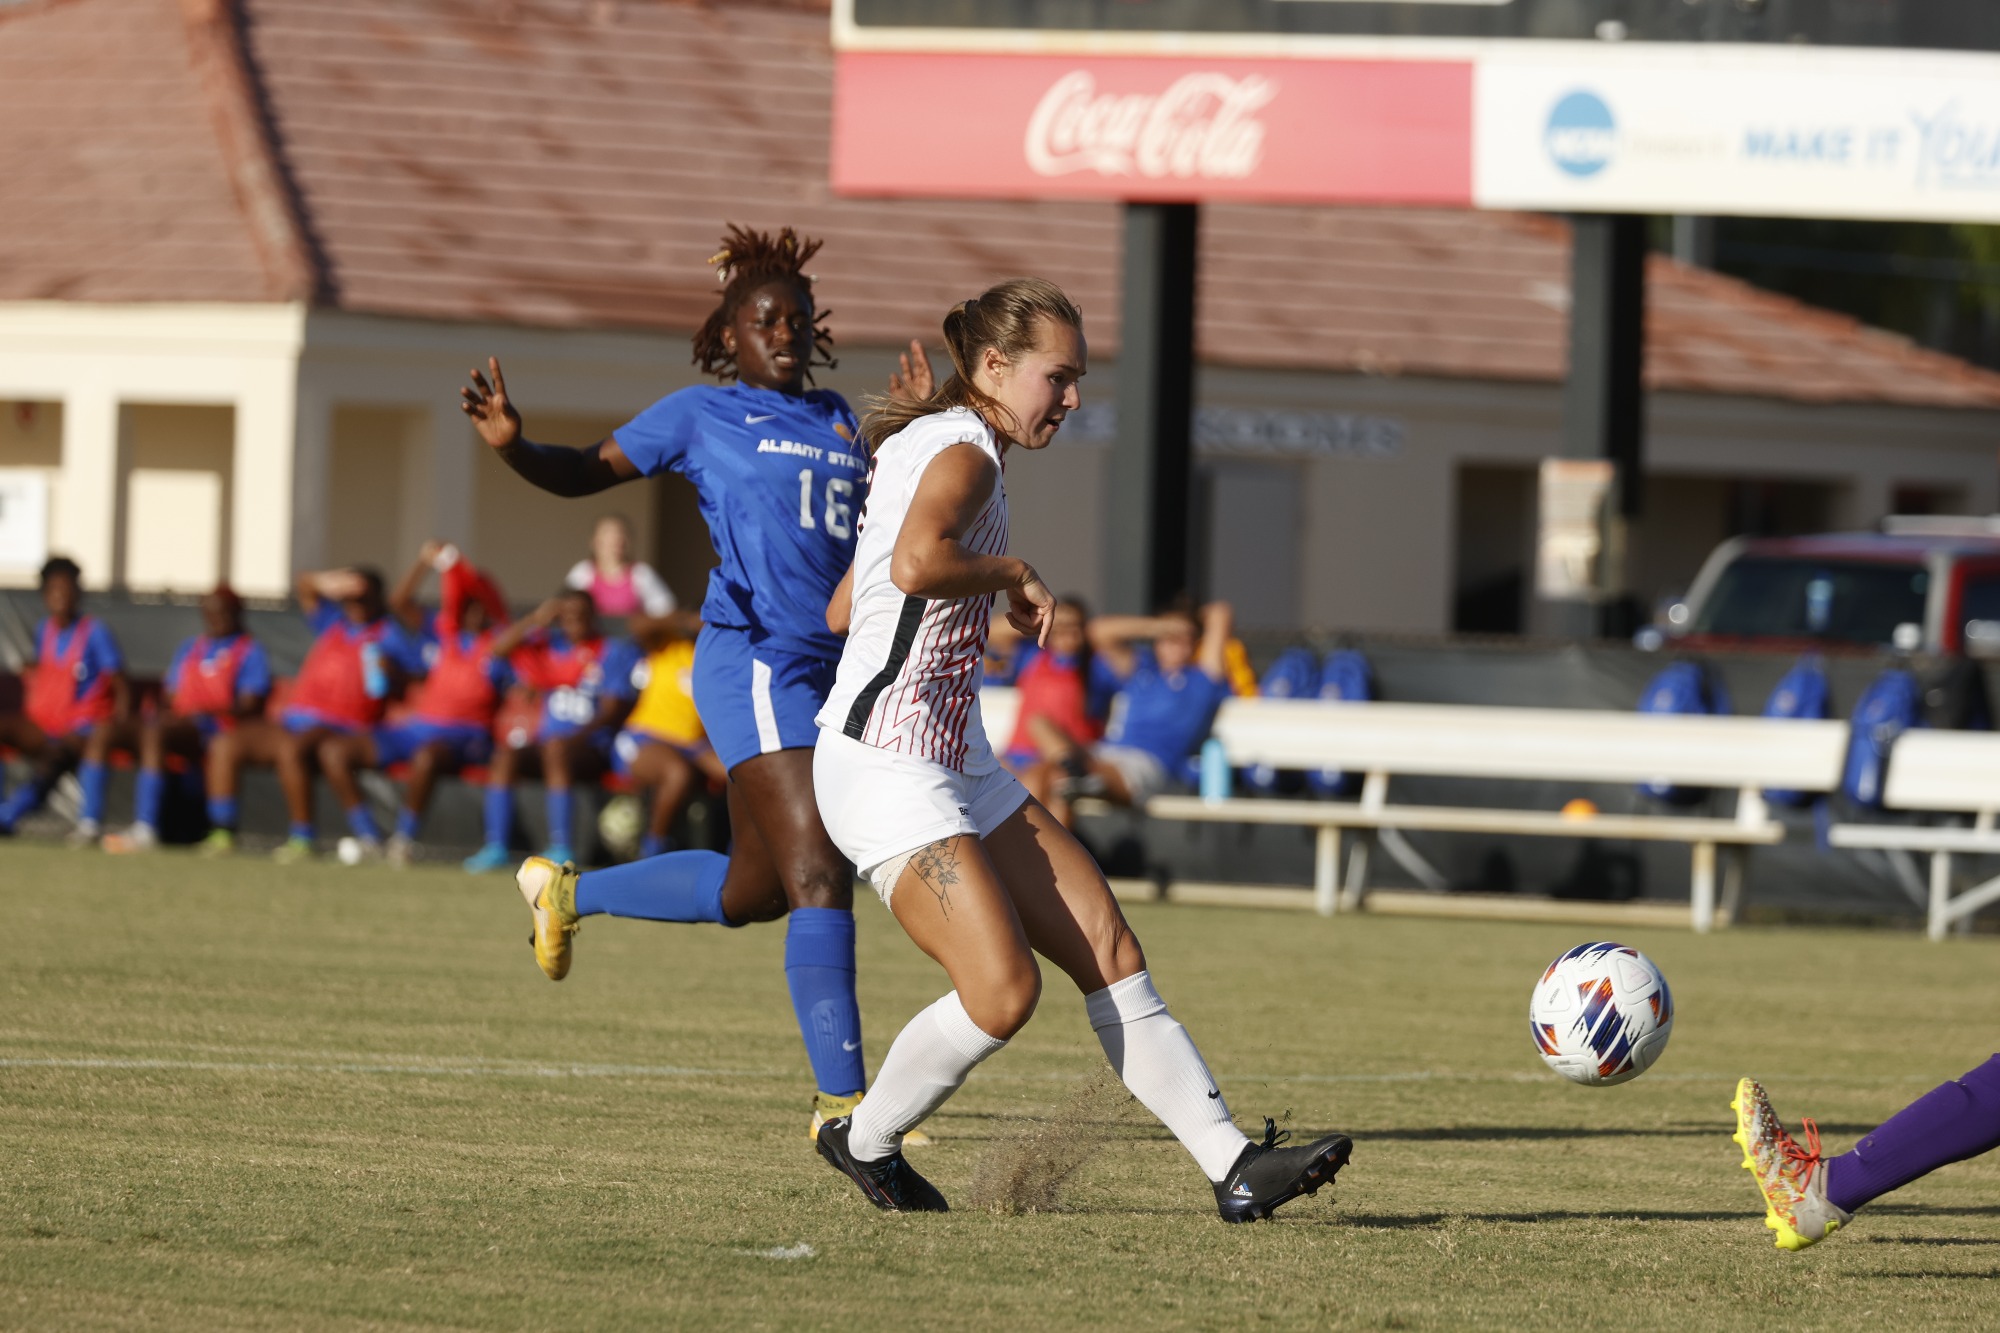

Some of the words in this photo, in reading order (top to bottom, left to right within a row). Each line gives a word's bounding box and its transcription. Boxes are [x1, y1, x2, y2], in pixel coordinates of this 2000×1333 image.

[1742, 126, 1854, 167] MAKE
[1868, 127, 1902, 170] IT
[757, 439, 823, 461] ALBANY
[799, 468, 853, 540] 16
